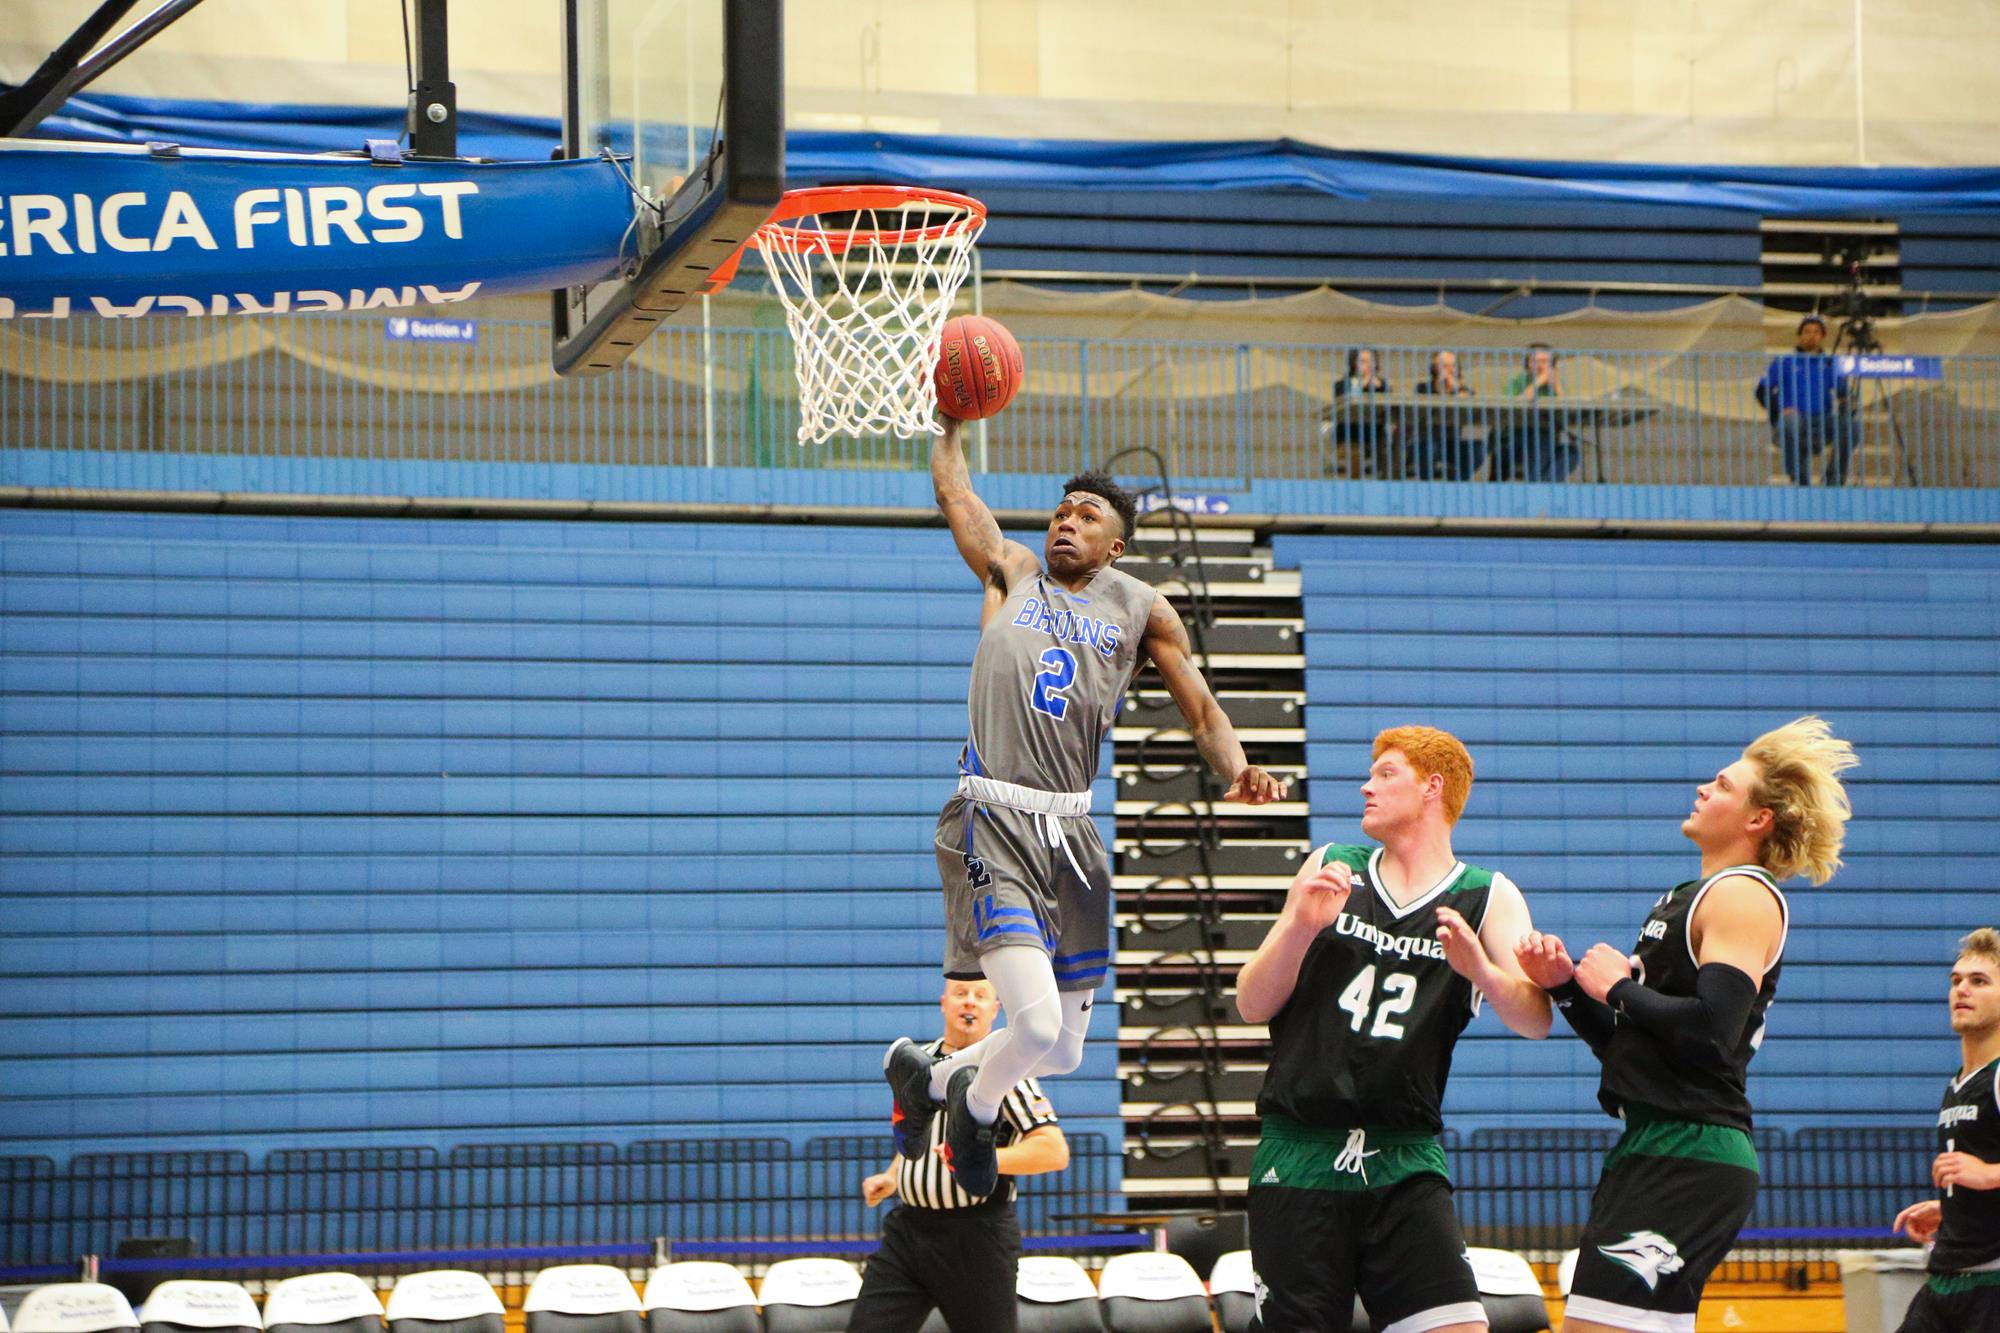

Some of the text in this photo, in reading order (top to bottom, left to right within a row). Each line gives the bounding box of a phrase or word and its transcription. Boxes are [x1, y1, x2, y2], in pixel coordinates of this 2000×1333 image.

[0, 181, 480, 256] RICA FIRST
[411, 320, 473, 339] Section J
[946, 340, 974, 409] SPALDING
[1859, 357, 1915, 373] Section K
[1195, 495, 1207, 513] K
[1012, 597, 1121, 657] BRUINS
[1030, 646, 1078, 721] 2
[1335, 912, 1446, 961] Umpqua
[1338, 964, 1417, 1040] 42
